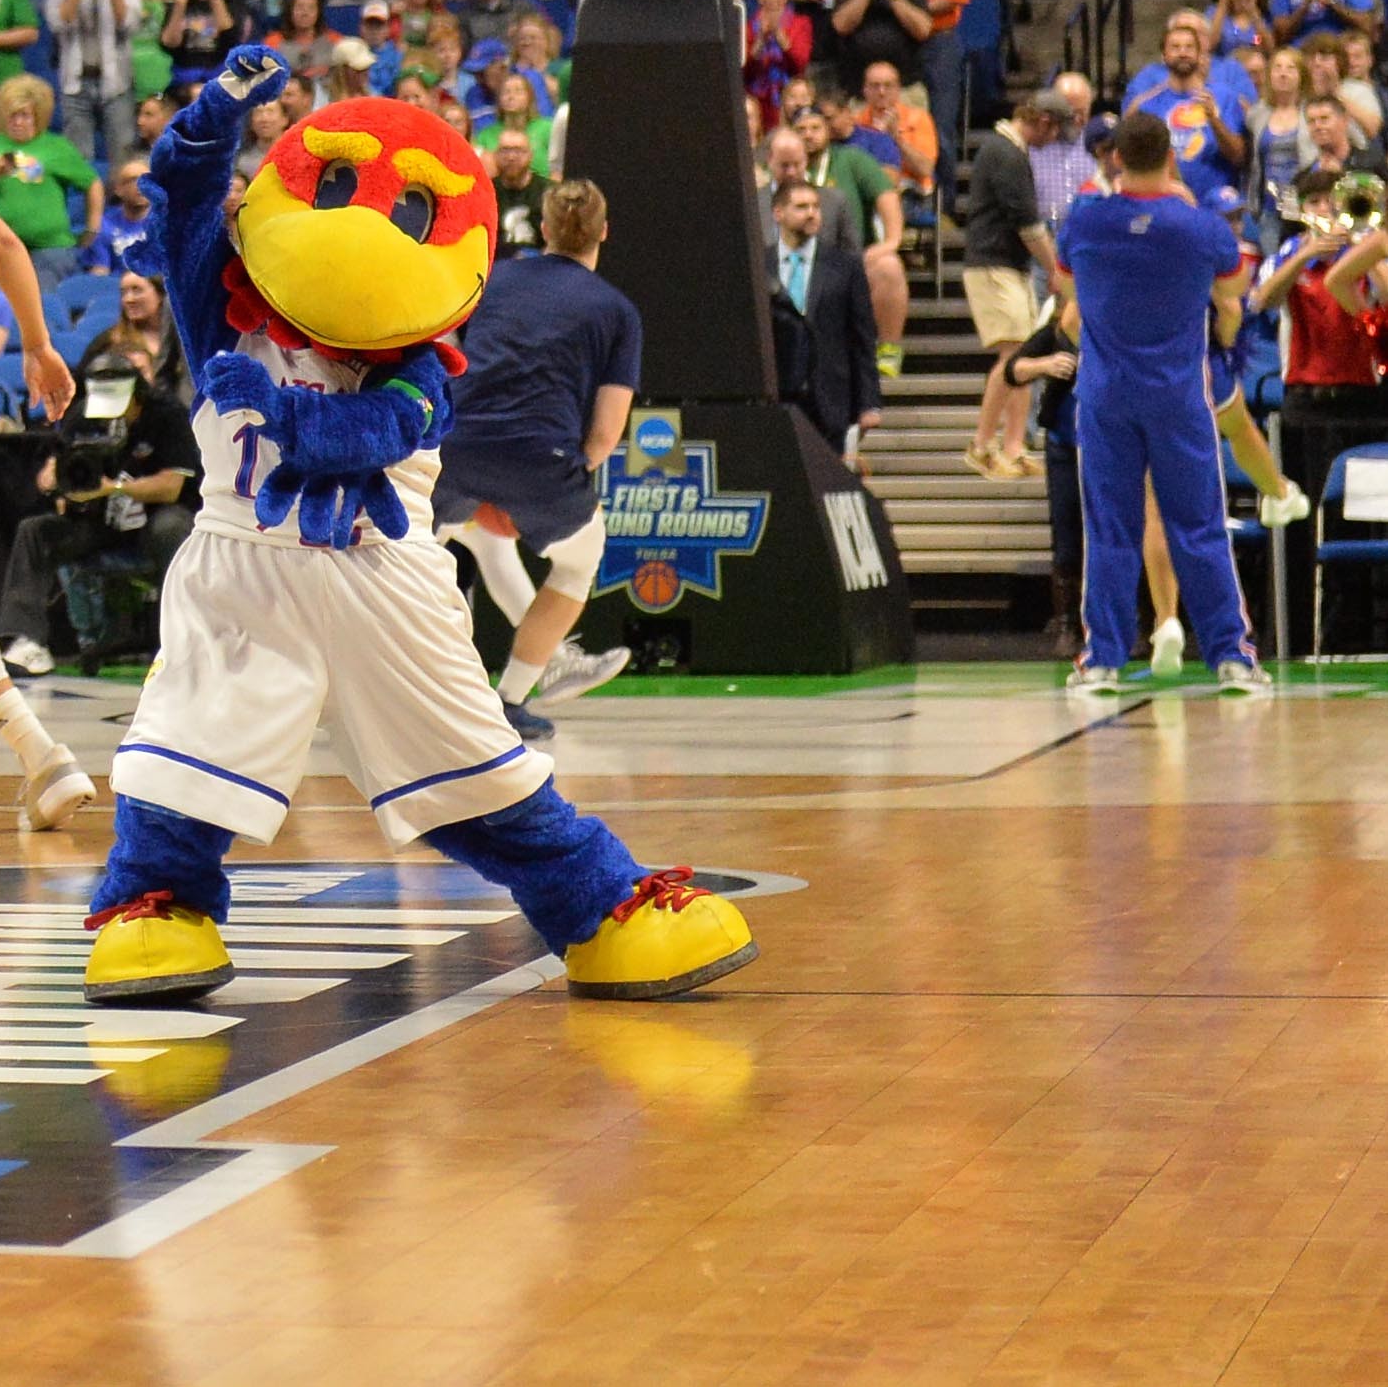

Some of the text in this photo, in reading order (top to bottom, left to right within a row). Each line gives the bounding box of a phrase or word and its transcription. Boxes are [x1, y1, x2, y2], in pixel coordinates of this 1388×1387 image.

[613, 485, 700, 512] FIRST &
[656, 511, 751, 538] ROUNDS
